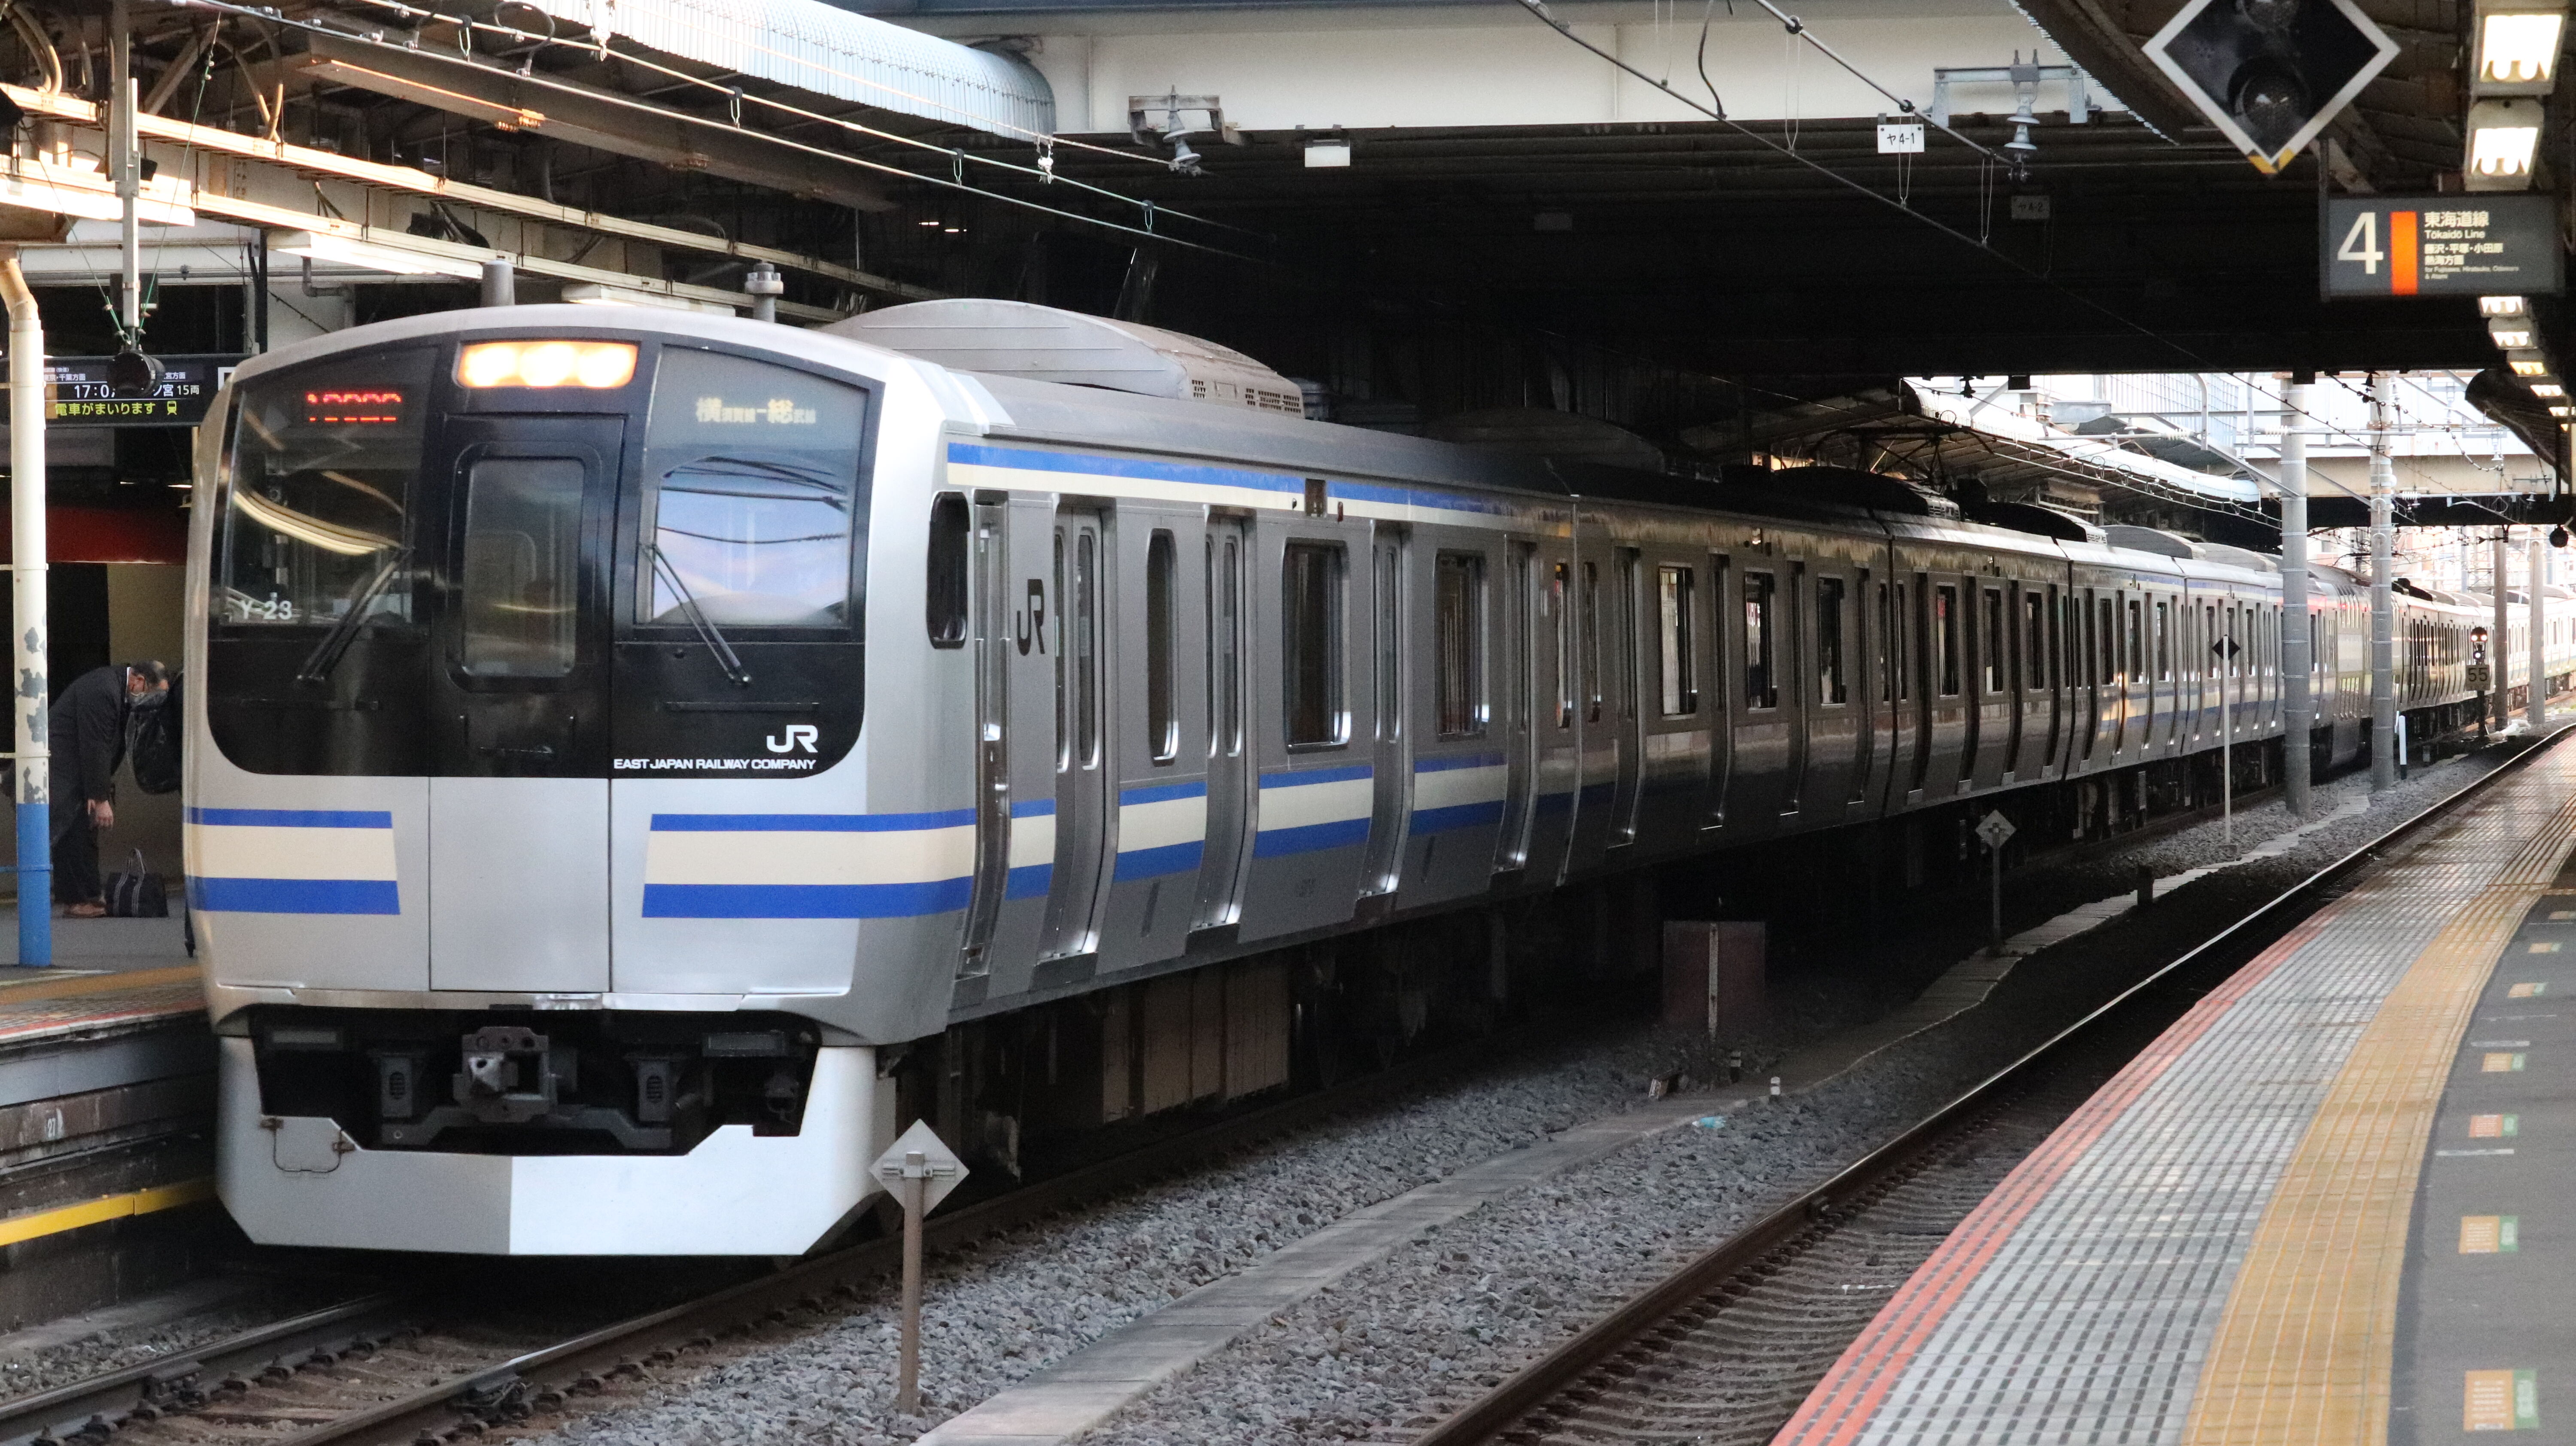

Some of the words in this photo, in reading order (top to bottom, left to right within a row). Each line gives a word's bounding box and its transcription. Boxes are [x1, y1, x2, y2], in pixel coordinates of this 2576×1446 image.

[2424, 211, 2489, 228] 東海道線
[2465, 229, 2485, 239] Line
[2337, 212, 2384, 274] 4
[164, 371, 186, 380] 宮方面
[177, 385, 200, 395] 15両
[55, 402, 156, 416] 電車がまいります
[1017, 579, 1045, 656] JR
[2468, 667, 2488, 682] 55
[766, 724, 818, 753] JR
[614, 759, 650, 769] EAST
[650, 759, 694, 769] JAPAN
[696, 759, 750, 769] RAILWAY
[751, 759, 816, 770] COMPANY
